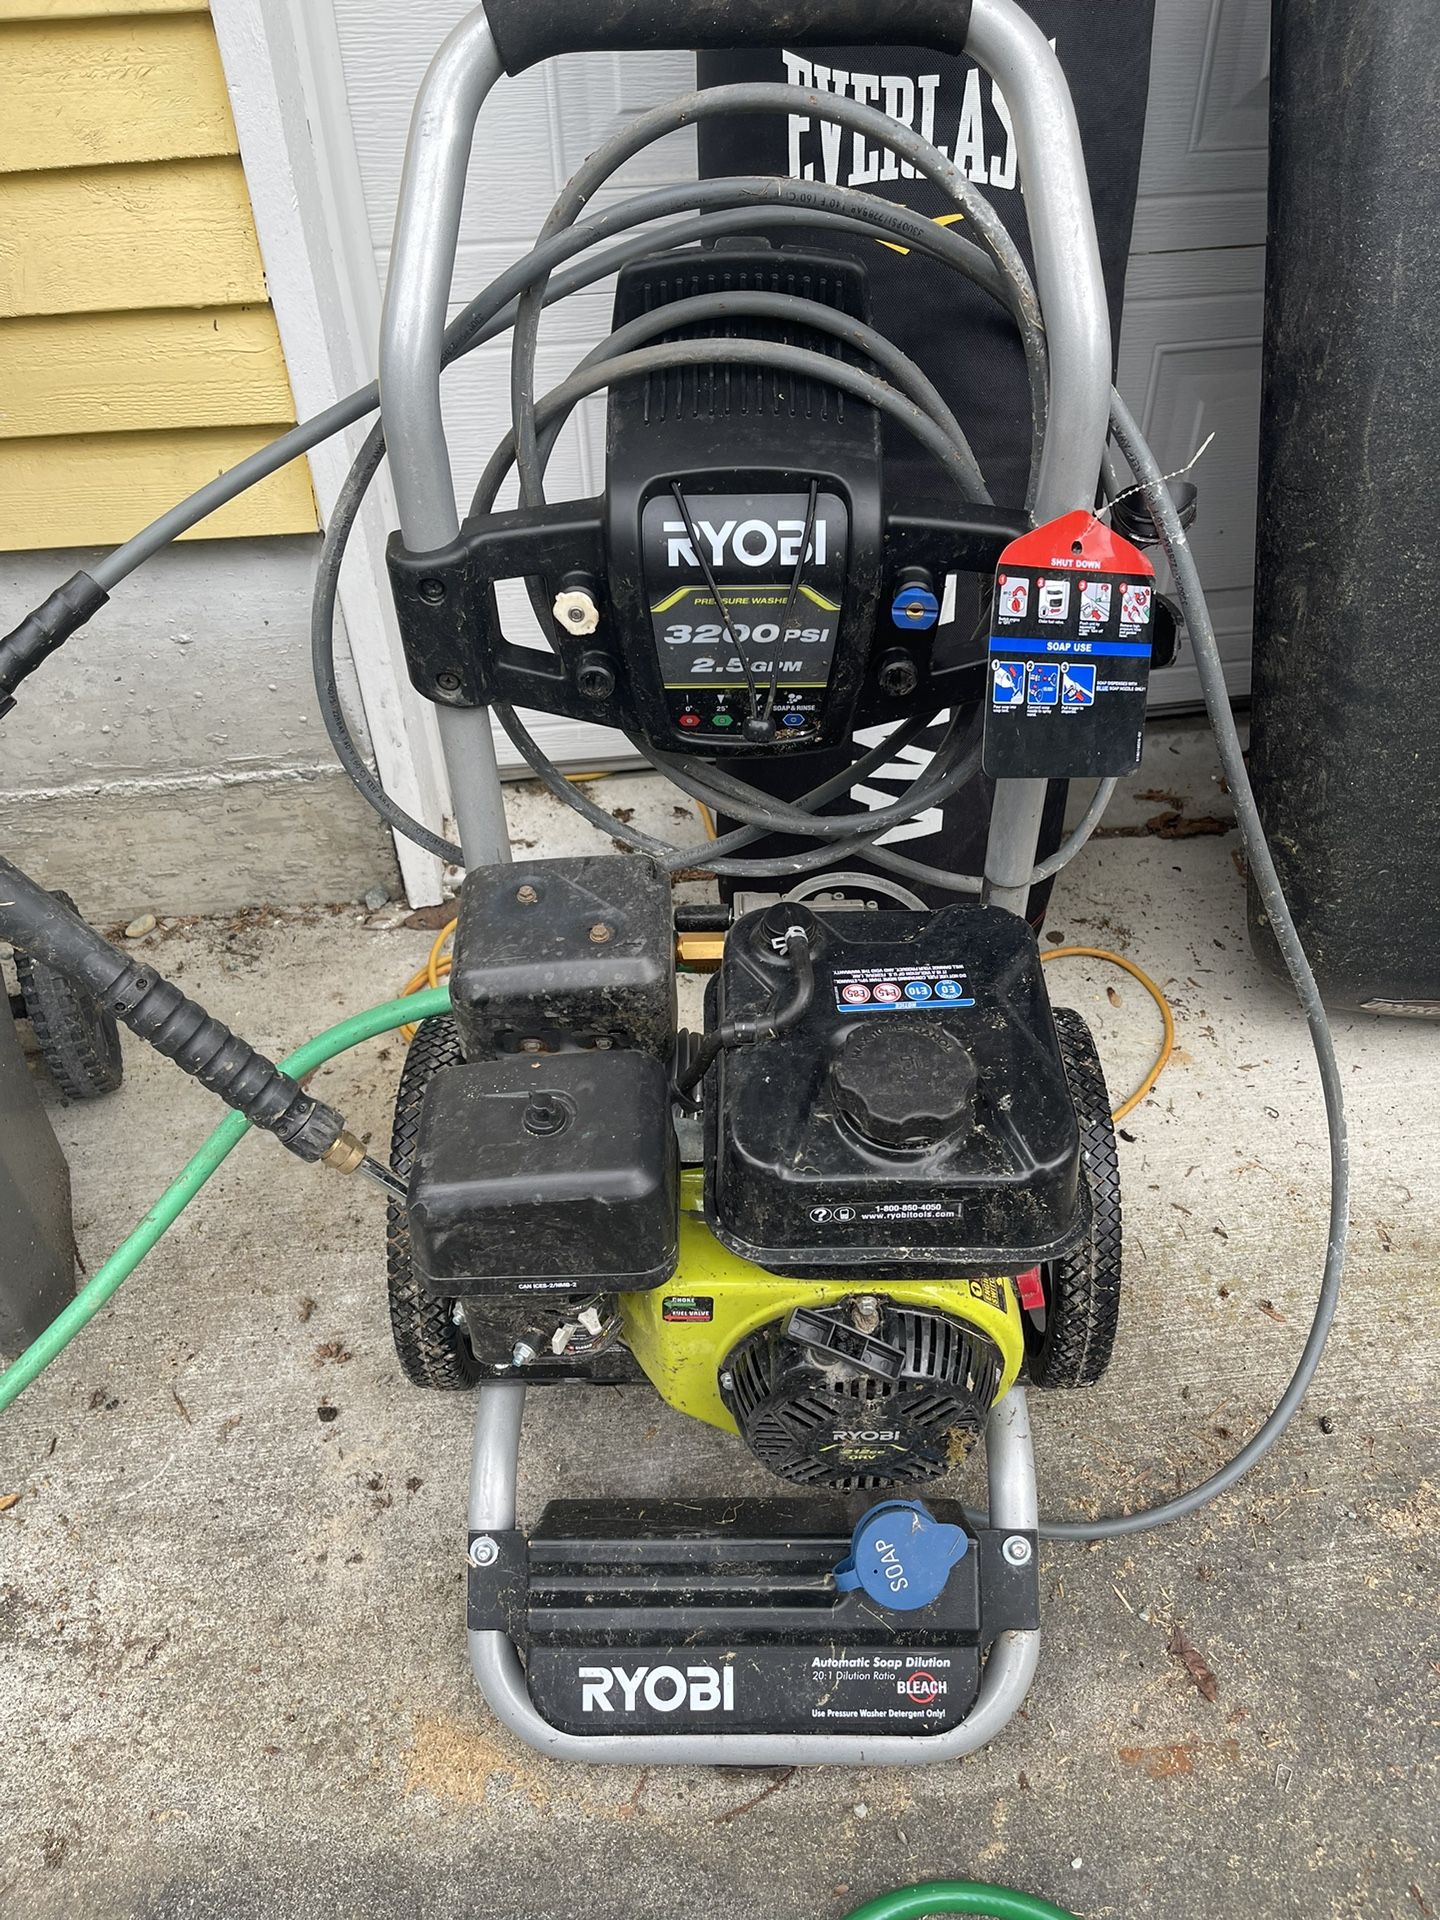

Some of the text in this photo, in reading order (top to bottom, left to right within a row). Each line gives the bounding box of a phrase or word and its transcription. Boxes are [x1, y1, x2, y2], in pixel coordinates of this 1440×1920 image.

[782, 38, 1056, 195] EVERLAS
[663, 519, 827, 567] RYOBI
[1051, 558, 1101, 569] SHUT DOWN
[664, 624, 830, 644] 3200 PSI
[1047, 642, 1092, 652] SOAP USE
[691, 657, 749, 672] 2.5
[909, 987, 928, 995] E10
[875, 1204, 941, 1212] 1-800-850-4050
[861, 1211, 955, 1220] www.ryobitools.com
[832, 1431, 900, 1441] RYOBI
[874, 1538, 909, 1593] SOAP
[811, 1657, 950, 1670] Automatic Soap Dilution
[812, 1670, 896, 1680] 20:1 Dilution Ratio
[578, 1666, 734, 1712] RYOBI
[897, 1681, 947, 1694] BLEACH
[812, 1709, 946, 1719] Use Pressure Washer Detergent Only!
